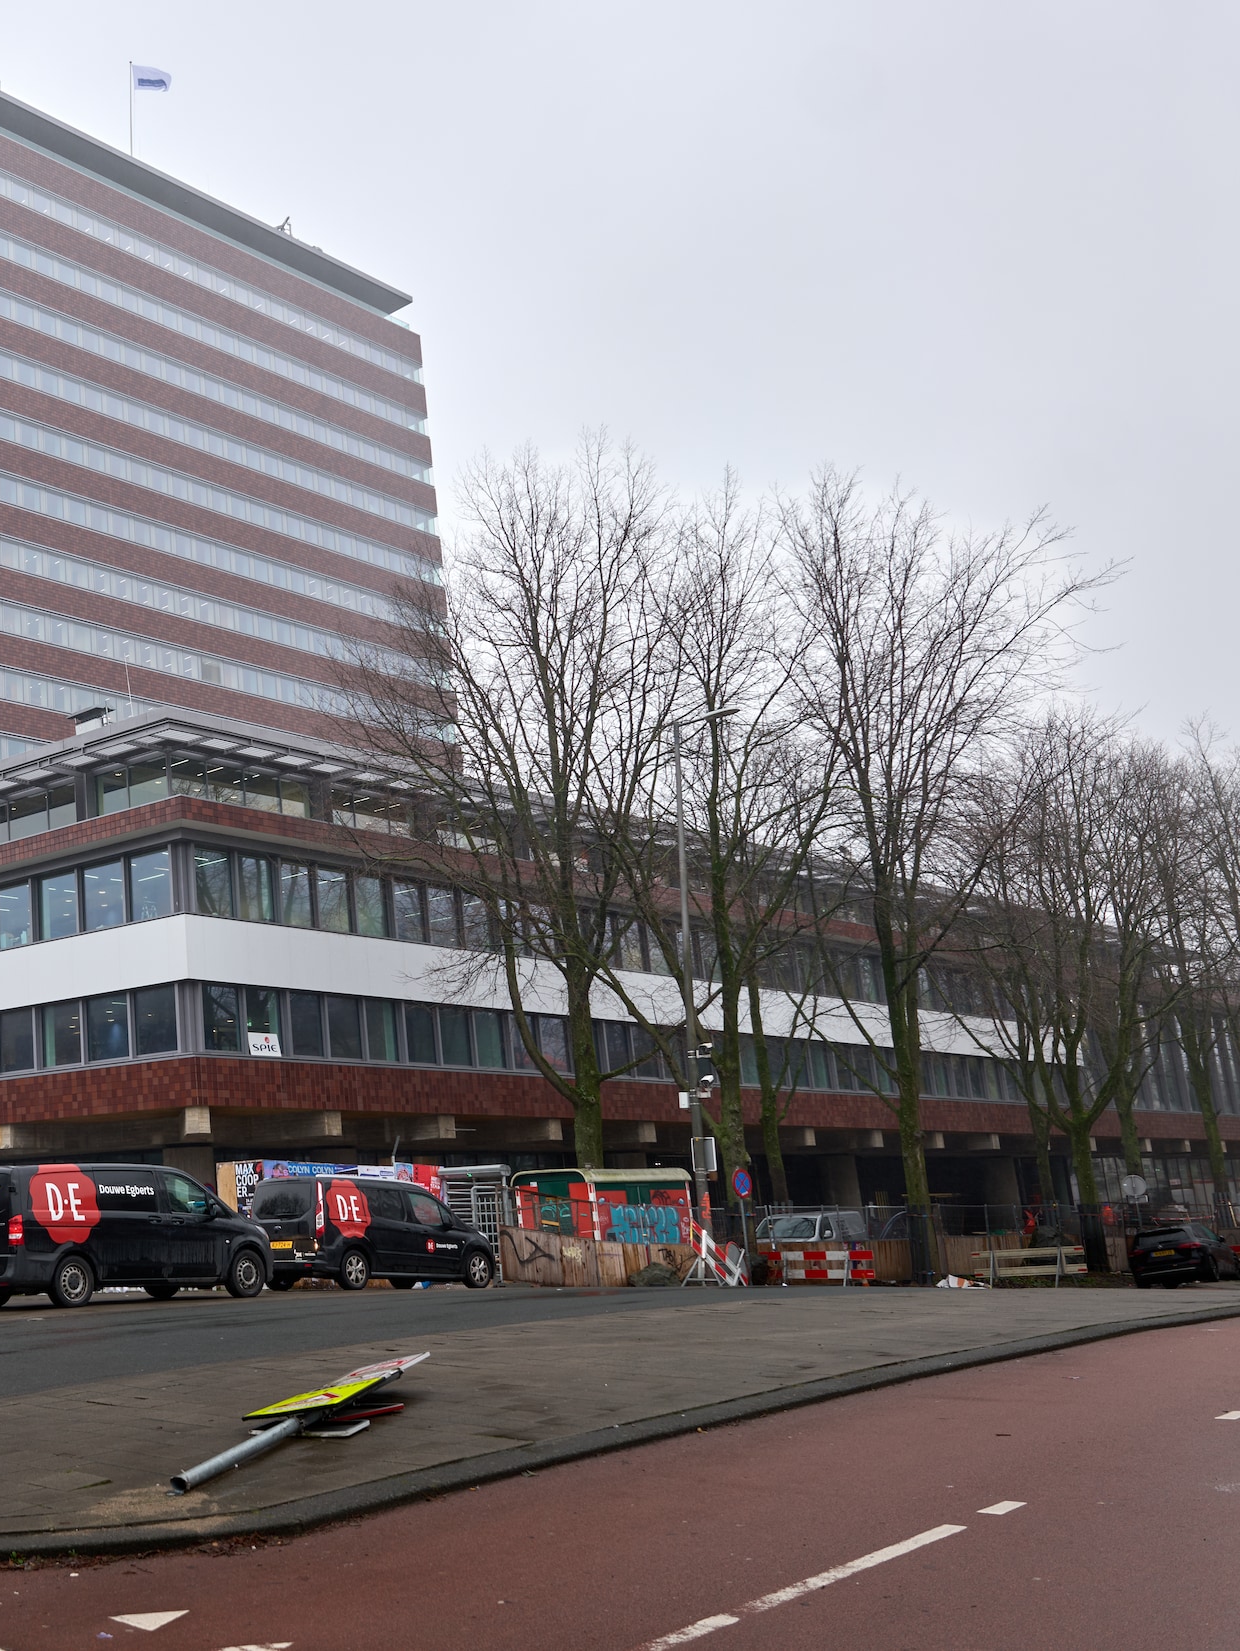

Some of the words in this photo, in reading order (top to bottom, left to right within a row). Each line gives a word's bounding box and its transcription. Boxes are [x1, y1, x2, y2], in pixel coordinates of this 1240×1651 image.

[252, 1043, 278, 1052] SPIE
[236, 1163, 254, 1175] MAX
[288, 1165, 310, 1174] COLYN
[312, 1166, 334, 1174] COLYN
[236, 1174, 259, 1186] COOP
[99, 1184, 125, 1194] Douwe
[125, 1185, 154, 1197] Egberts
[237, 1186, 247, 1197] ER
